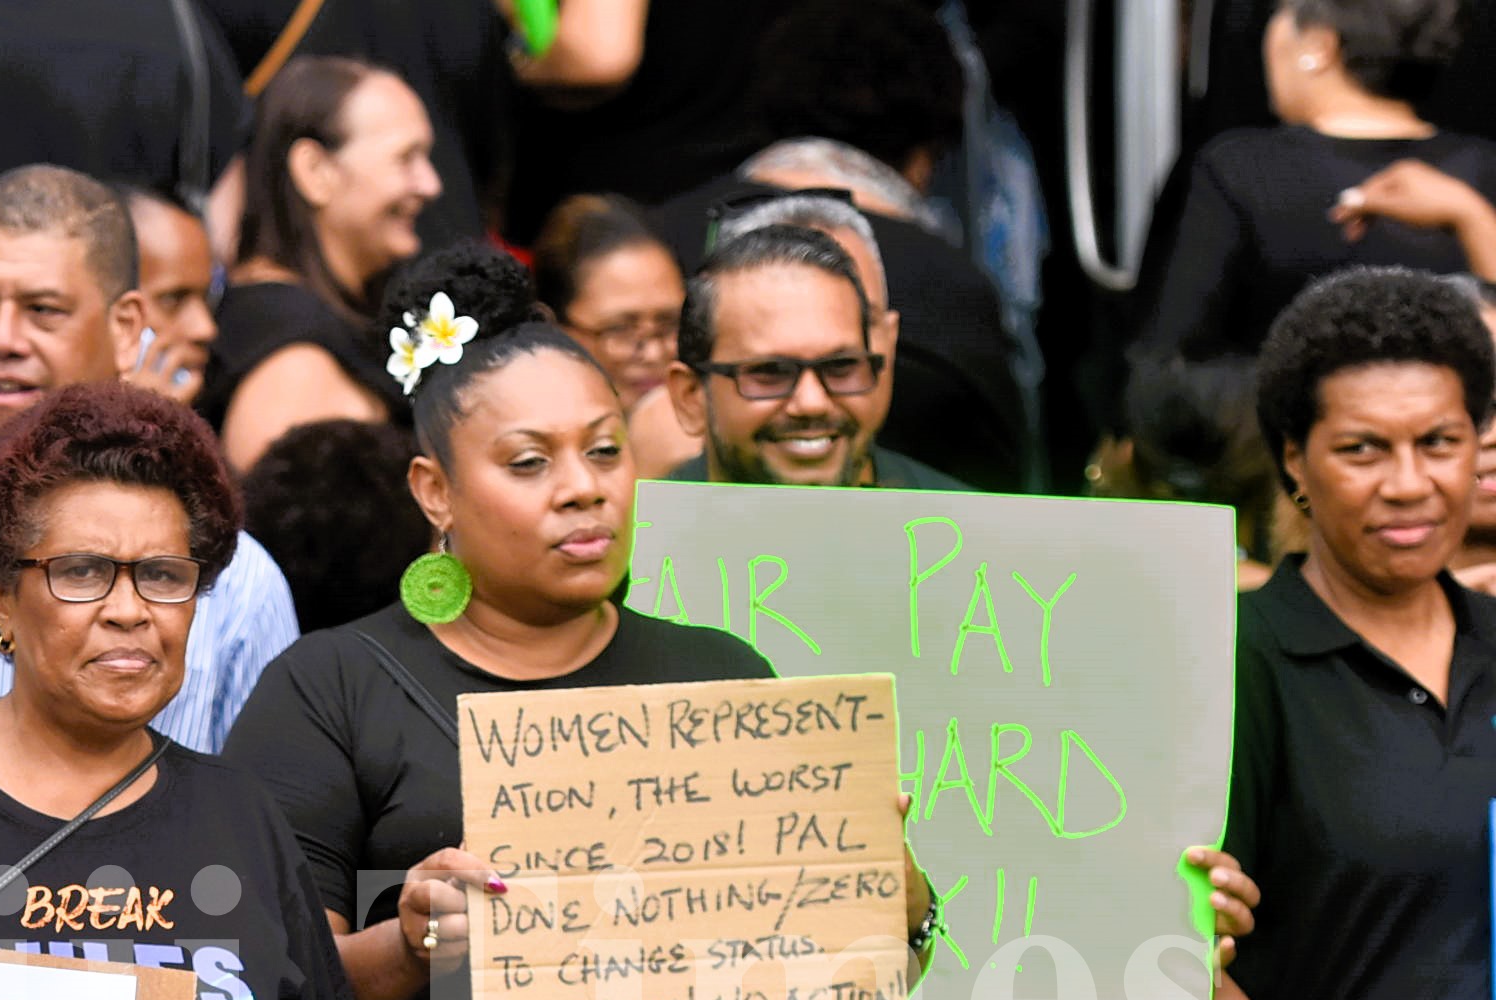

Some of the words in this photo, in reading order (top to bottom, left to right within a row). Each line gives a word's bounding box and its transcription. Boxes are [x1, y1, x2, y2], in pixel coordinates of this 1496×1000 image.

[903, 515, 1077, 686] PAY
[467, 703, 651, 767] WOMEN
[628, 772, 712, 810] THE
[732, 763, 853, 798] WORST
[489, 840, 615, 878] SINCE
[775, 811, 867, 856] PAL
[19, 884, 175, 933] BREAK
[489, 896, 592, 936] DONE
[557, 943, 690, 985] CHANGE
